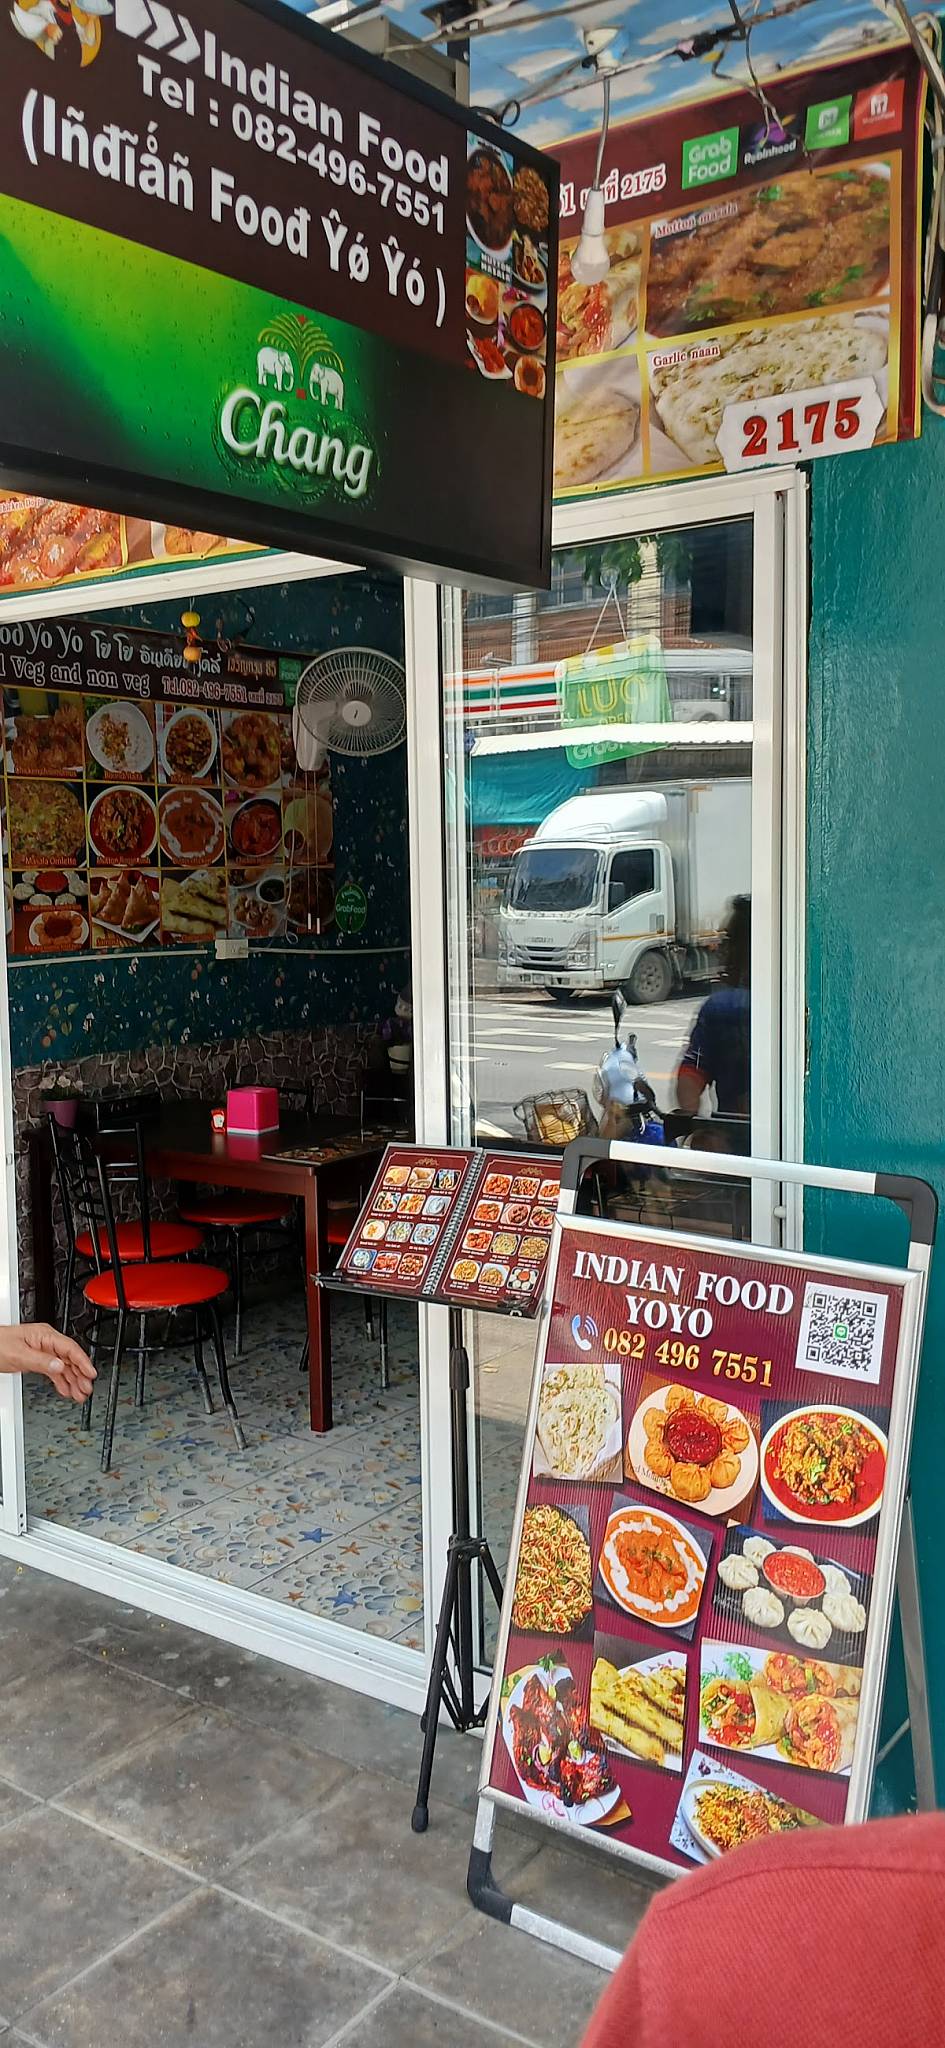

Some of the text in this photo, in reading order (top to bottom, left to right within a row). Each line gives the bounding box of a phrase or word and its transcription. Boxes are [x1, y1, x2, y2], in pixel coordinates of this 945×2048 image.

[204, 29, 449, 197] Indian Food
[137, 54, 195, 116] Tel
[232, 102, 444, 235] 082-496-7551
[688, 136, 732, 184] Grab Food
[621, 164, 666, 200] 2175
[652, 345, 720, 368] Garlic naan
[221, 388, 374, 499] Chang
[741, 396, 862, 458] 2175
[56, 625, 84, 660] Yo
[10, 655, 46, 687] Veg
[50, 662, 83, 685] and
[86, 668, 119, 689] non
[122, 673, 151, 698] veg
[572, 1250, 794, 1316] INDIAN FOOD
[625, 1294, 714, 1339] YOYO
[603, 1327, 773, 1388] 082 496 7551
